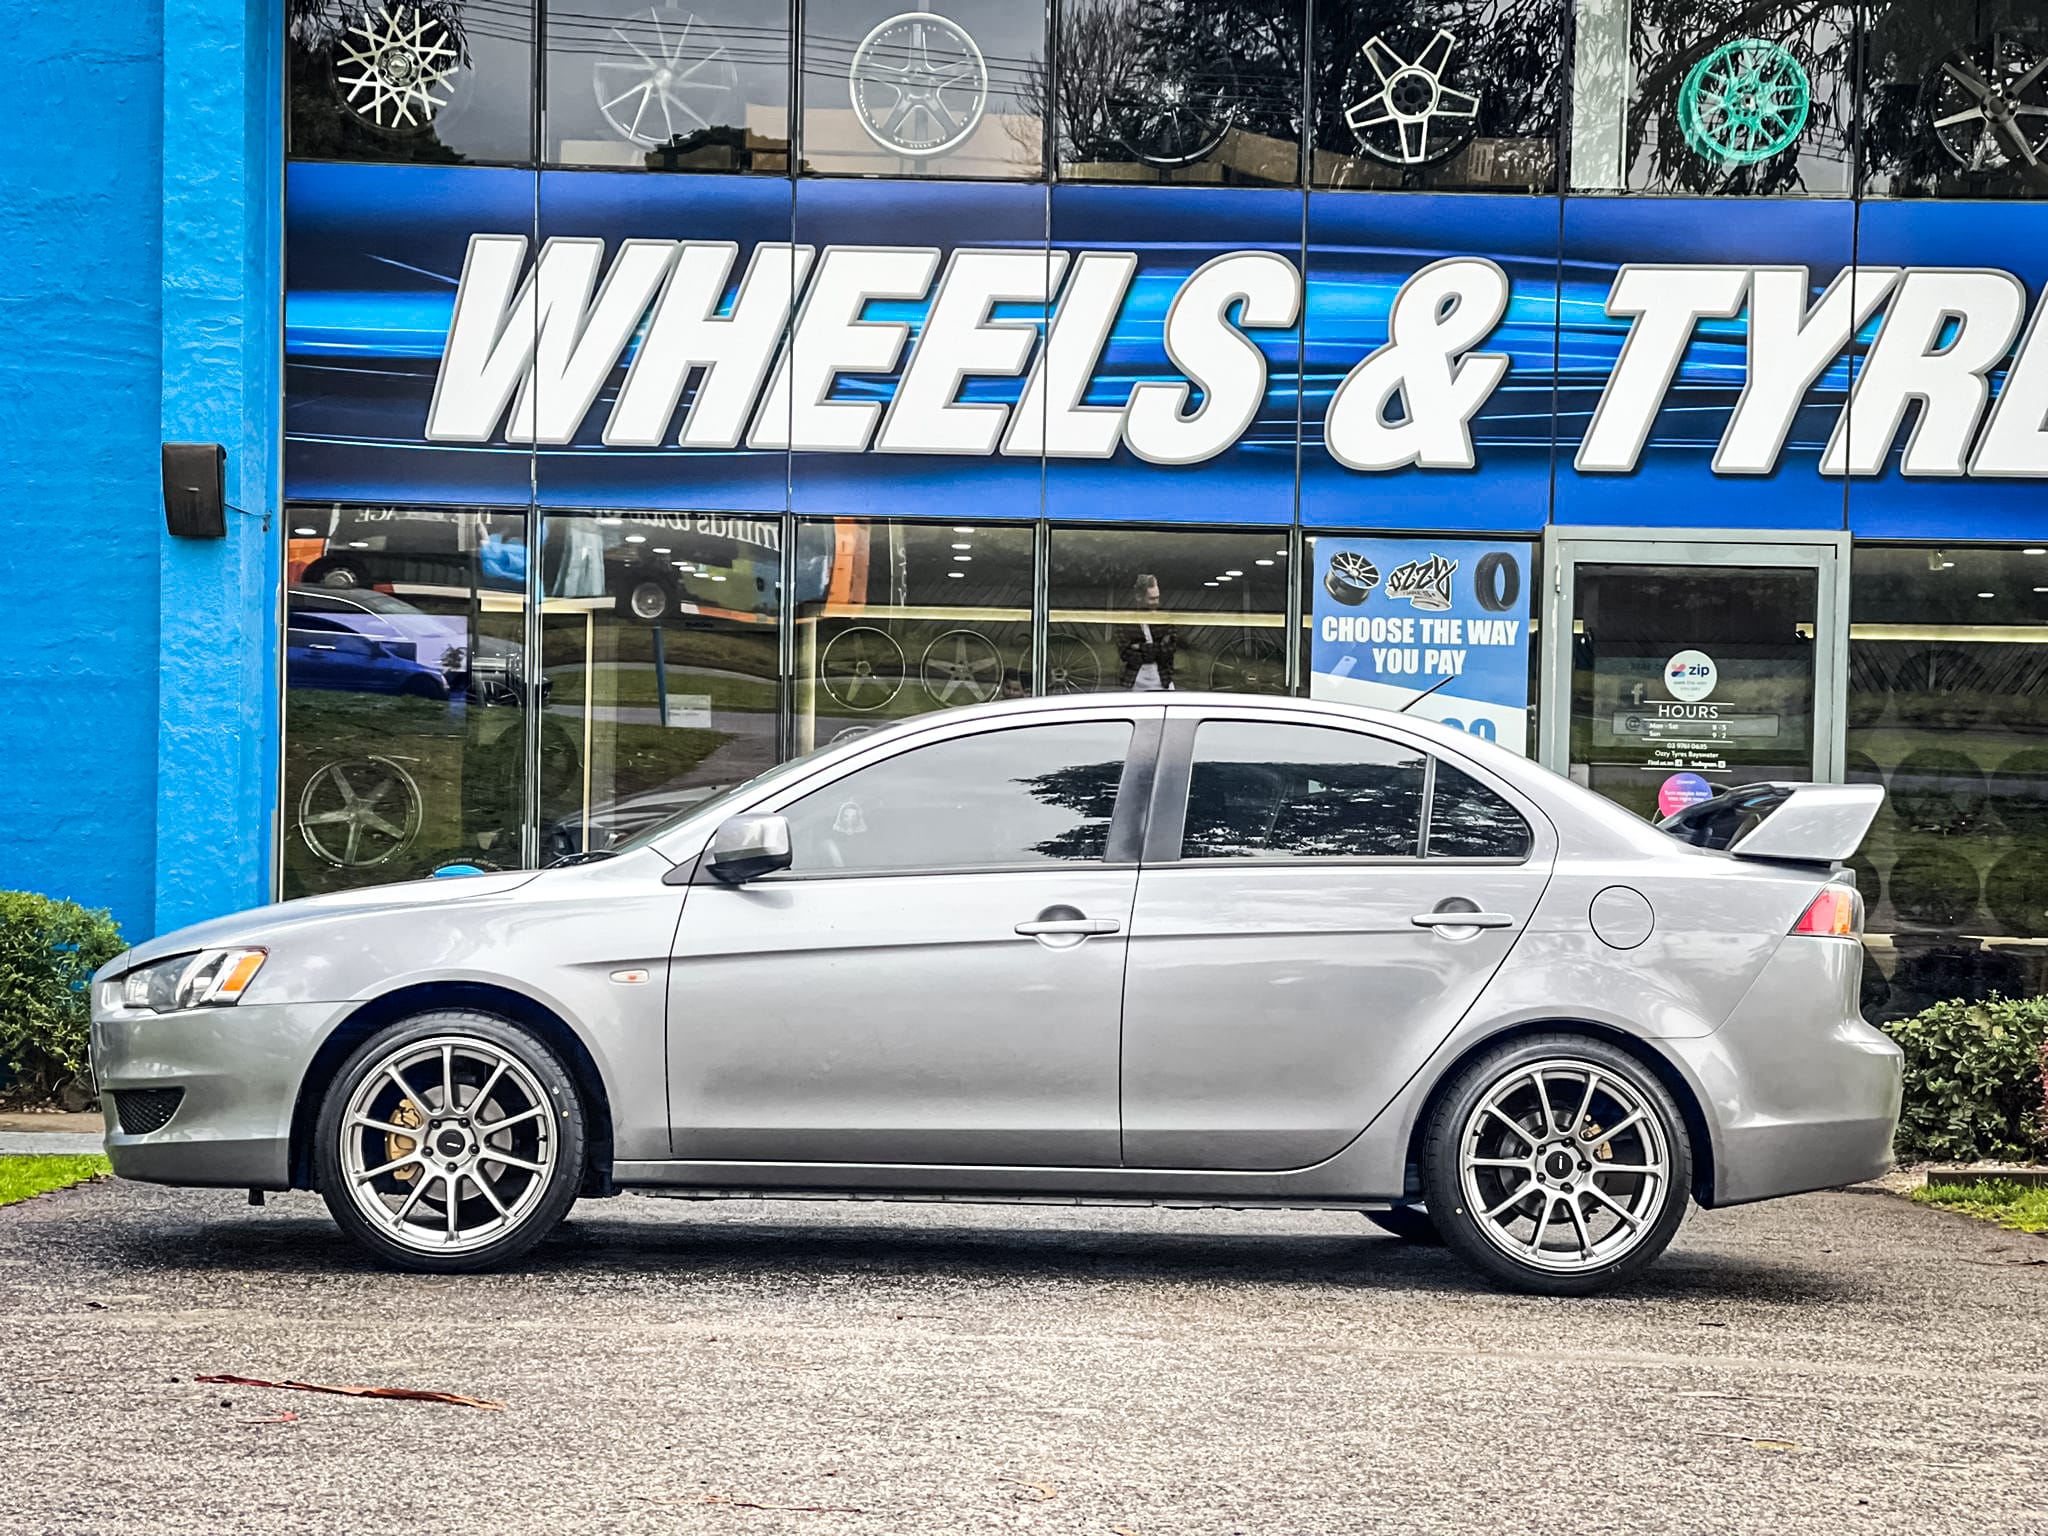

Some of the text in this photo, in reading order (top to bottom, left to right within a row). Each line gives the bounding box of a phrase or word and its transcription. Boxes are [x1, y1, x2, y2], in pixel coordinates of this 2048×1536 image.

[424, 233, 1302, 466] WHEELS
[1324, 256, 1510, 472] &
[1321, 616, 1520, 646] CHOOSE THE WAY
[1372, 648, 1467, 675] YOU PAY
[1688, 663, 1710, 678] zip
[1658, 704, 1719, 719] HOURS
